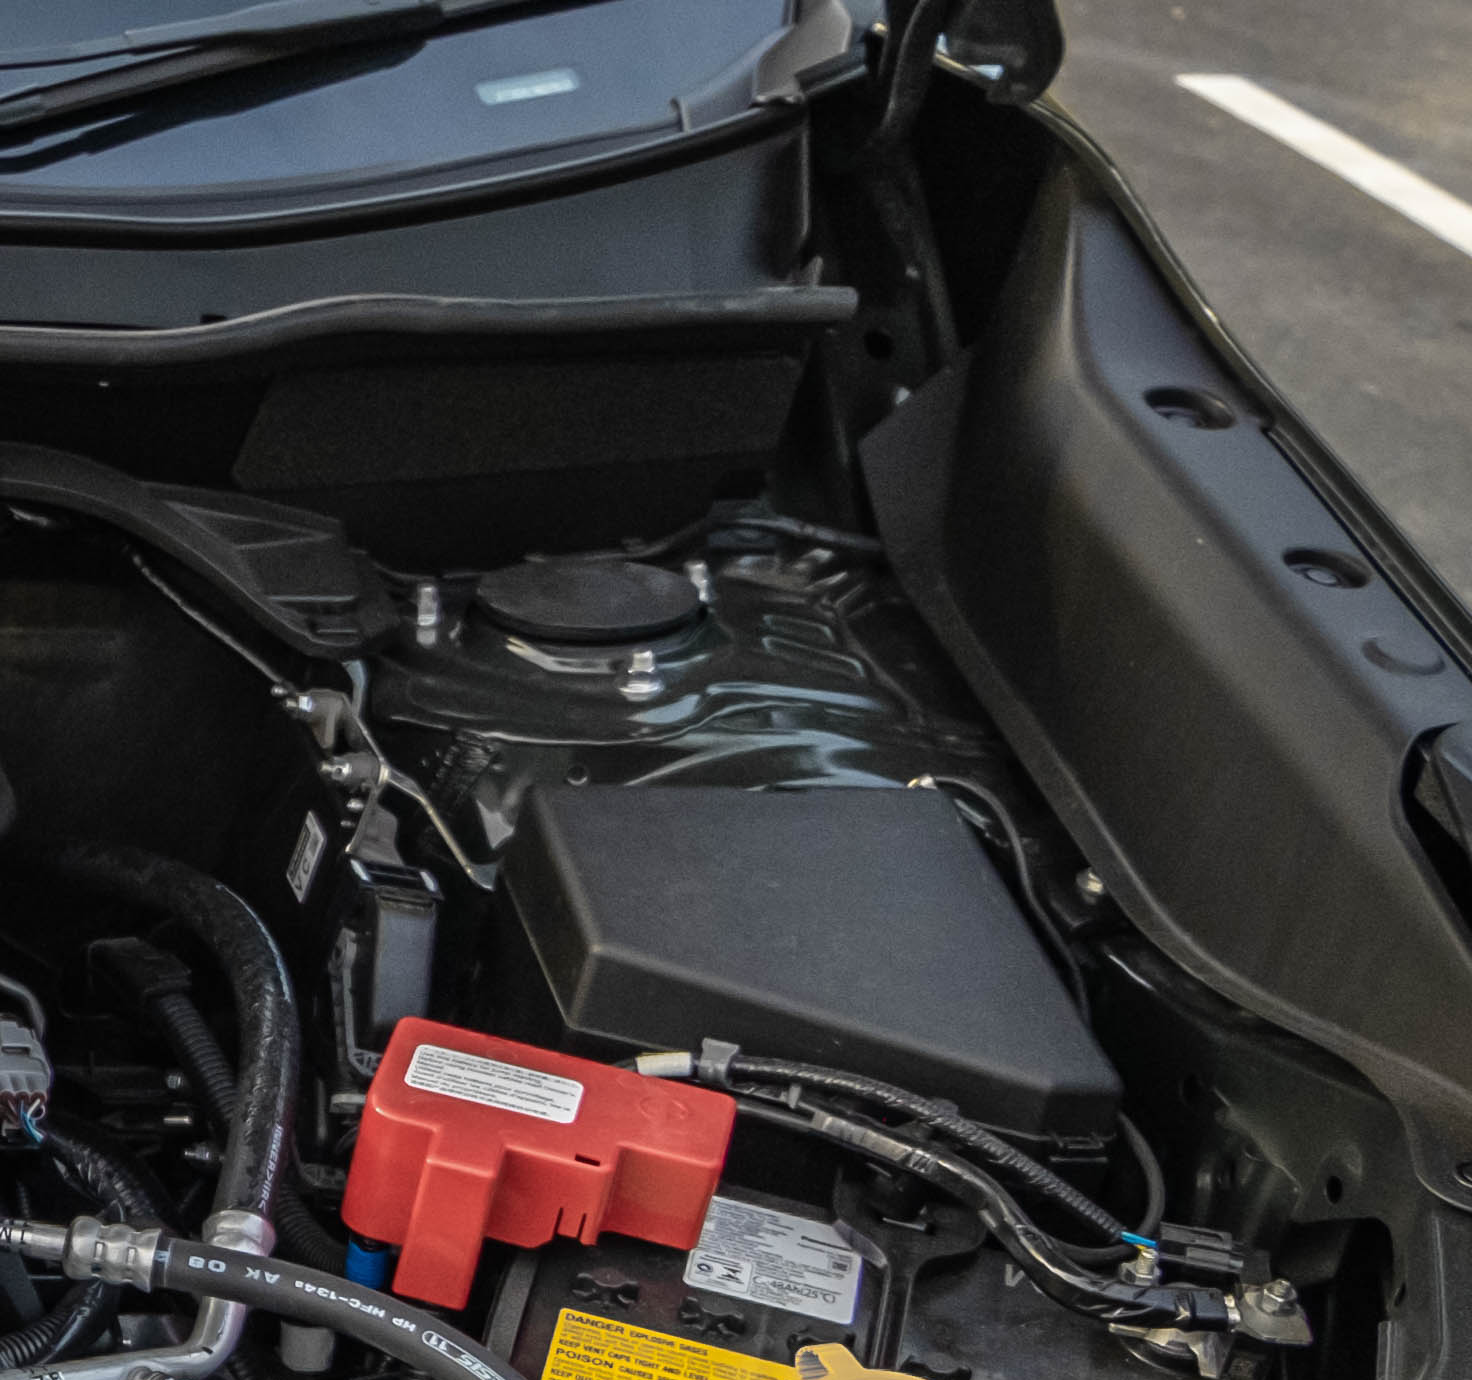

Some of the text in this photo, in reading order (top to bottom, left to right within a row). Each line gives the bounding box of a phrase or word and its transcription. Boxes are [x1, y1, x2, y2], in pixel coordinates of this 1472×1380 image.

[245, 1266, 281, 1284] AK
[392, 1317, 416, 1333] HP
[564, 1312, 625, 1335] DANGER
[556, 1347, 615, 1370] POISON
